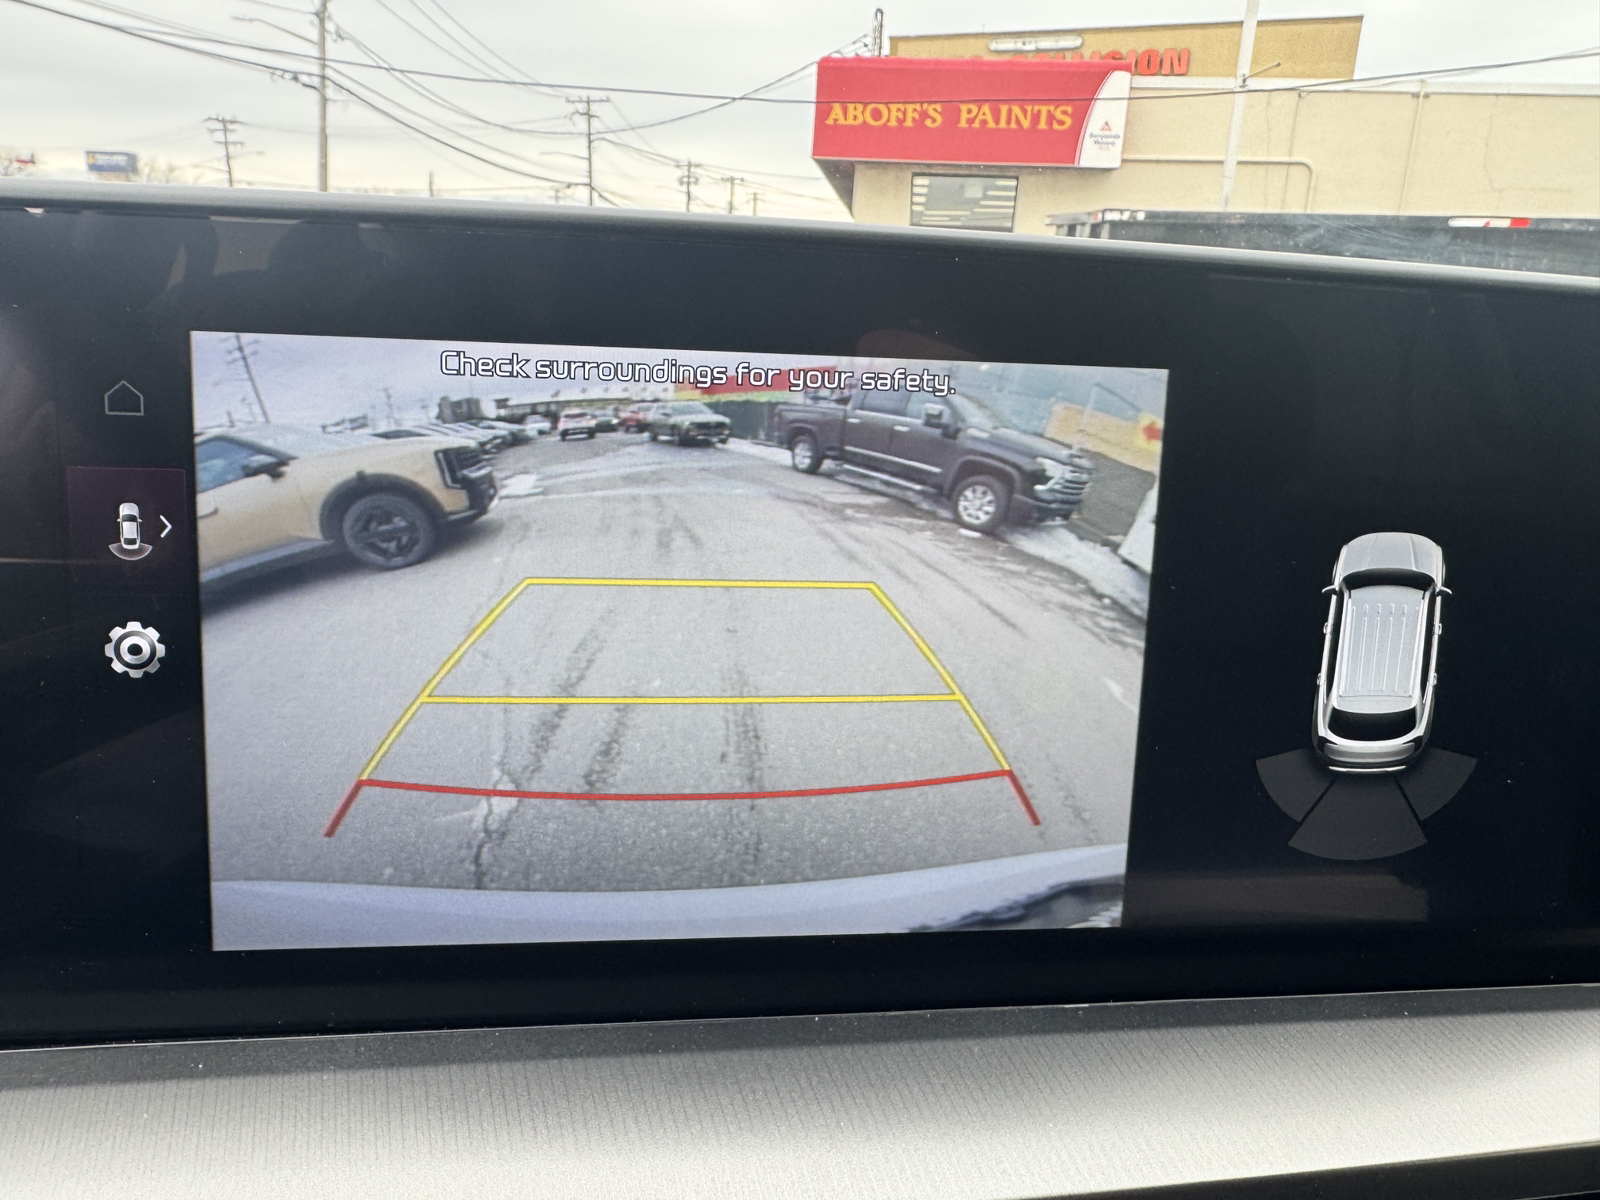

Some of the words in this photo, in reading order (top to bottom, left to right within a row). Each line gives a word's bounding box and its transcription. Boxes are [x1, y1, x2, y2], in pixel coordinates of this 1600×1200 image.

[825, 102, 943, 128] ABOFF'S
[957, 102, 1073, 130] PAINTS
[440, 350, 531, 378] Check
[535, 358, 728, 388] surroundings
[736, 362, 781, 386] for
[788, 367, 854, 391] your
[861, 367, 956, 397] safety.
